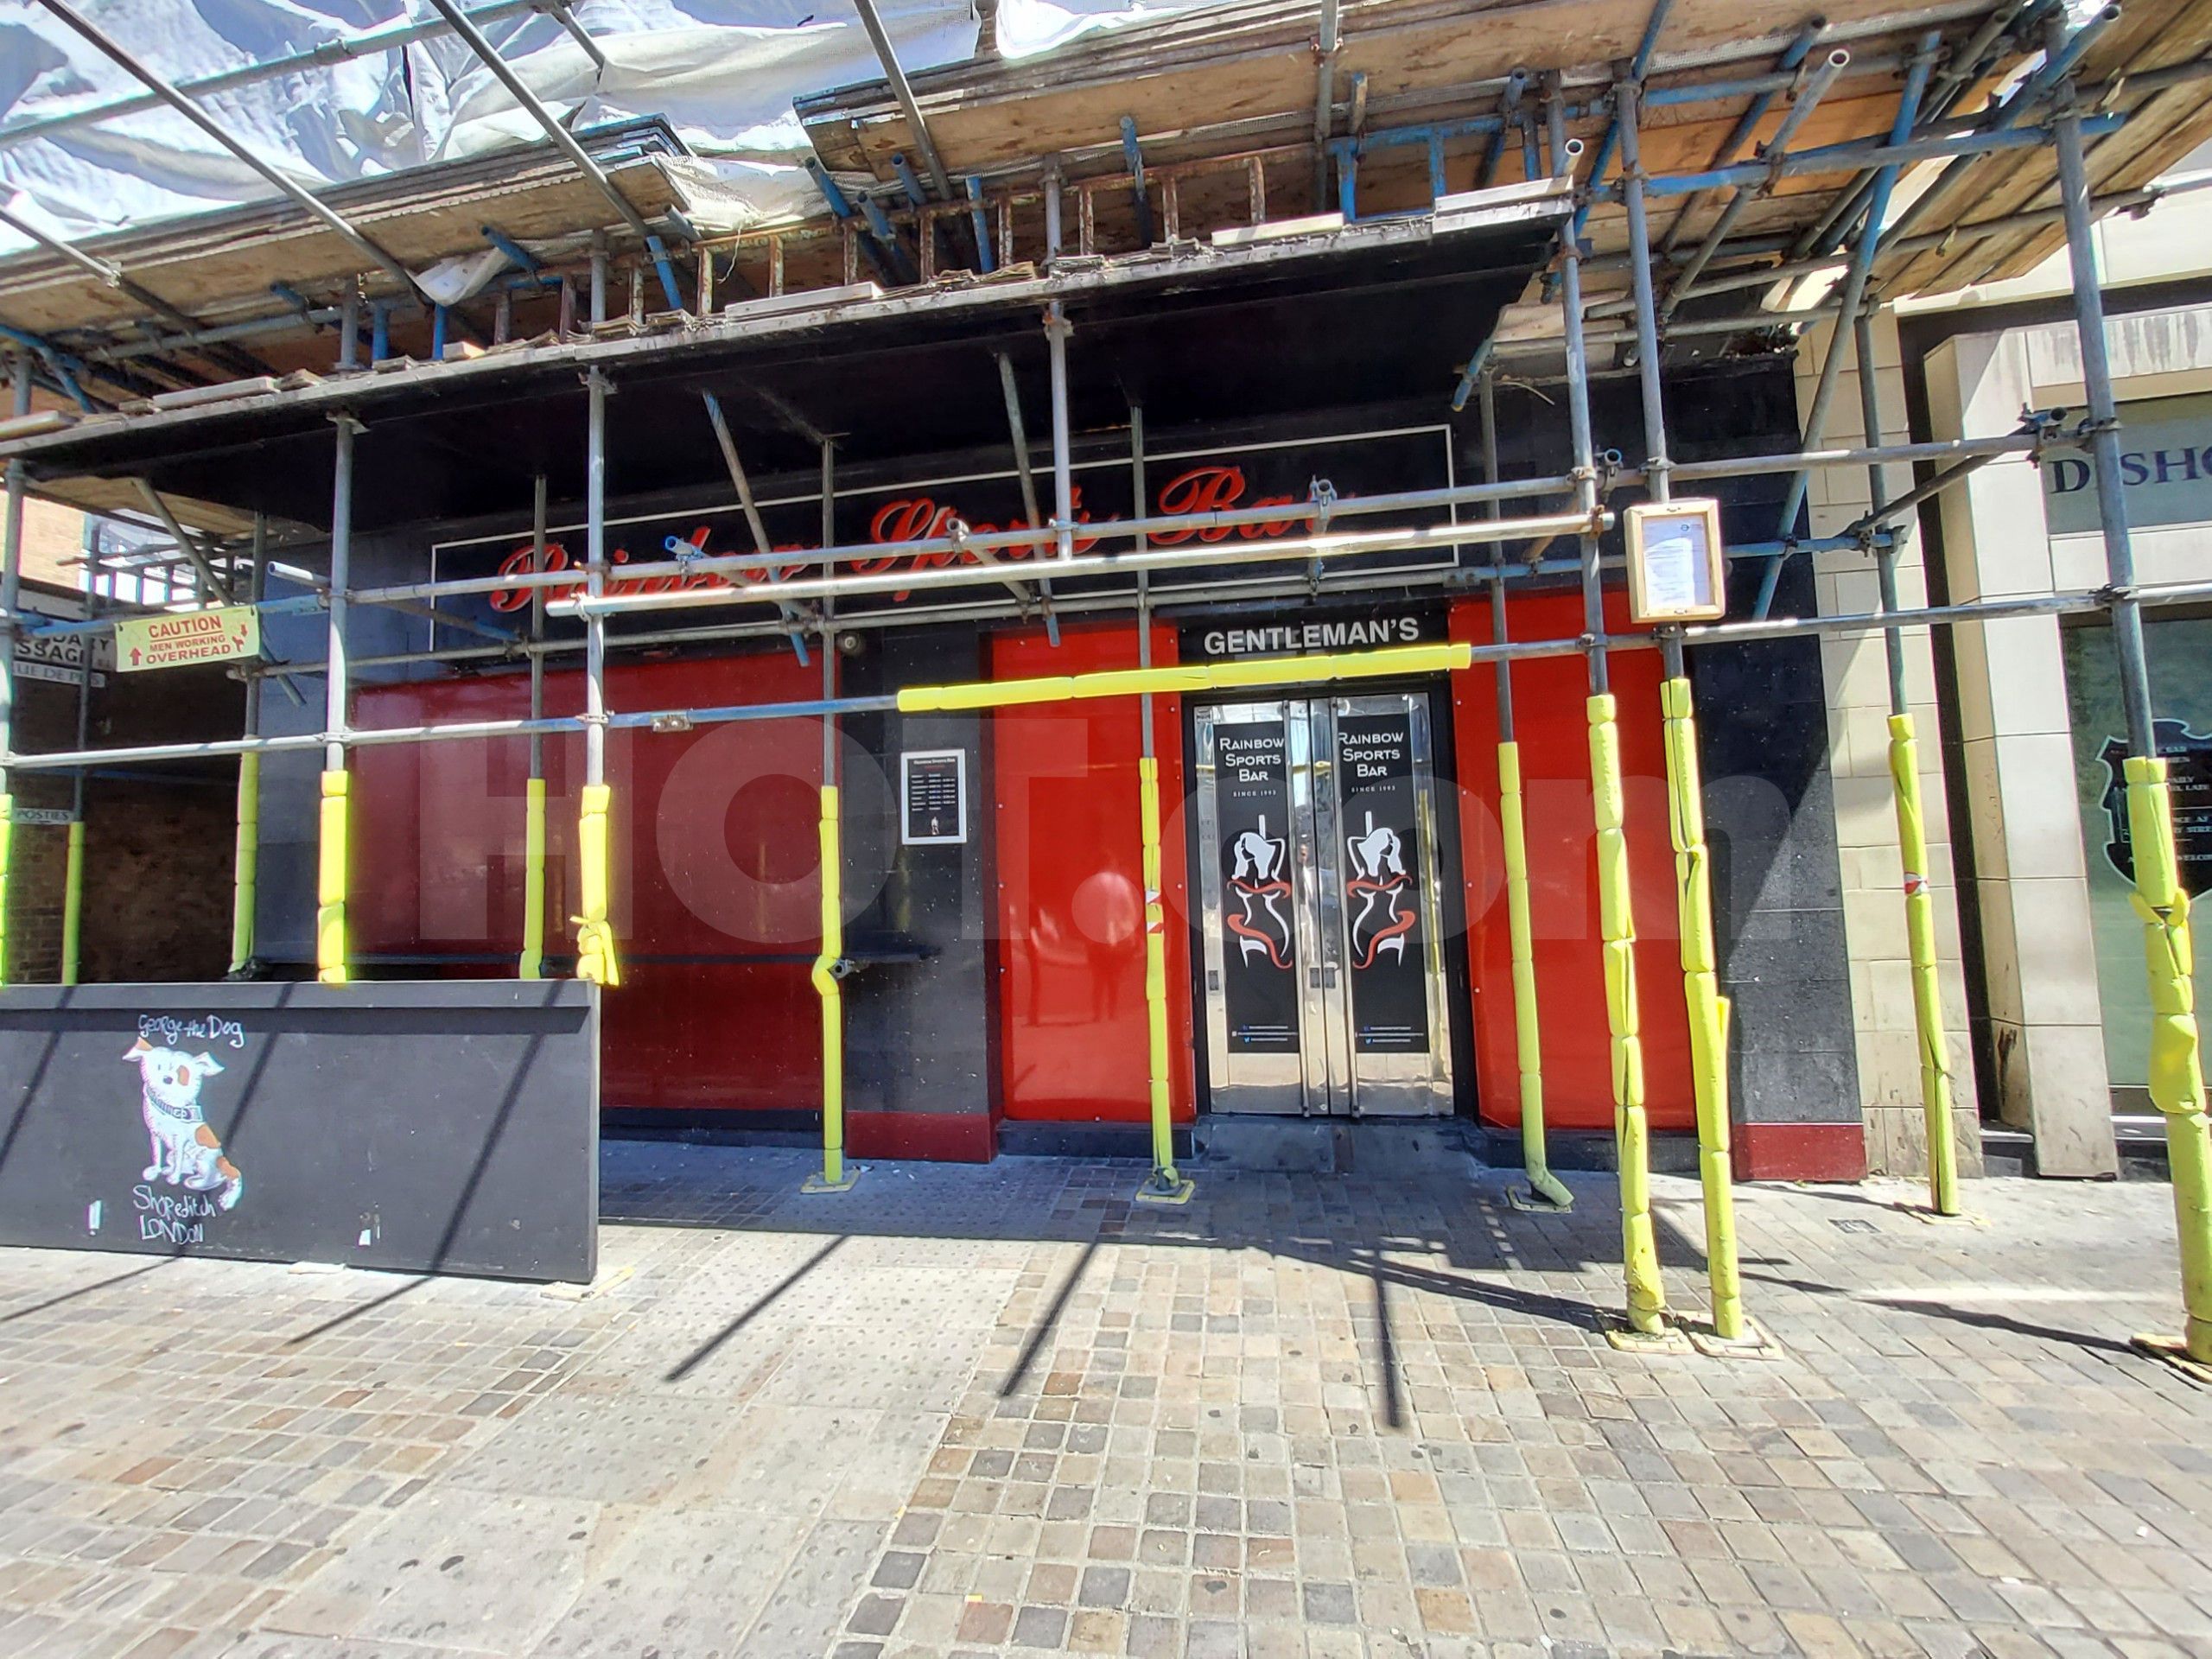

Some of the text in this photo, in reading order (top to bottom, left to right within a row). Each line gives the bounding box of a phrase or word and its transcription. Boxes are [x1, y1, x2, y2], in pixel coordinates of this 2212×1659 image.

[2047, 446, 2212, 493] DSH
[148, 615, 222, 639] CAUTION
[1204, 617, 1420, 655] GENTLEMAN'S
[146, 645, 231, 664] OVERHEAD
[149, 634, 226, 652] MEN WORKING
[207, 1014, 245, 1048] Dog
